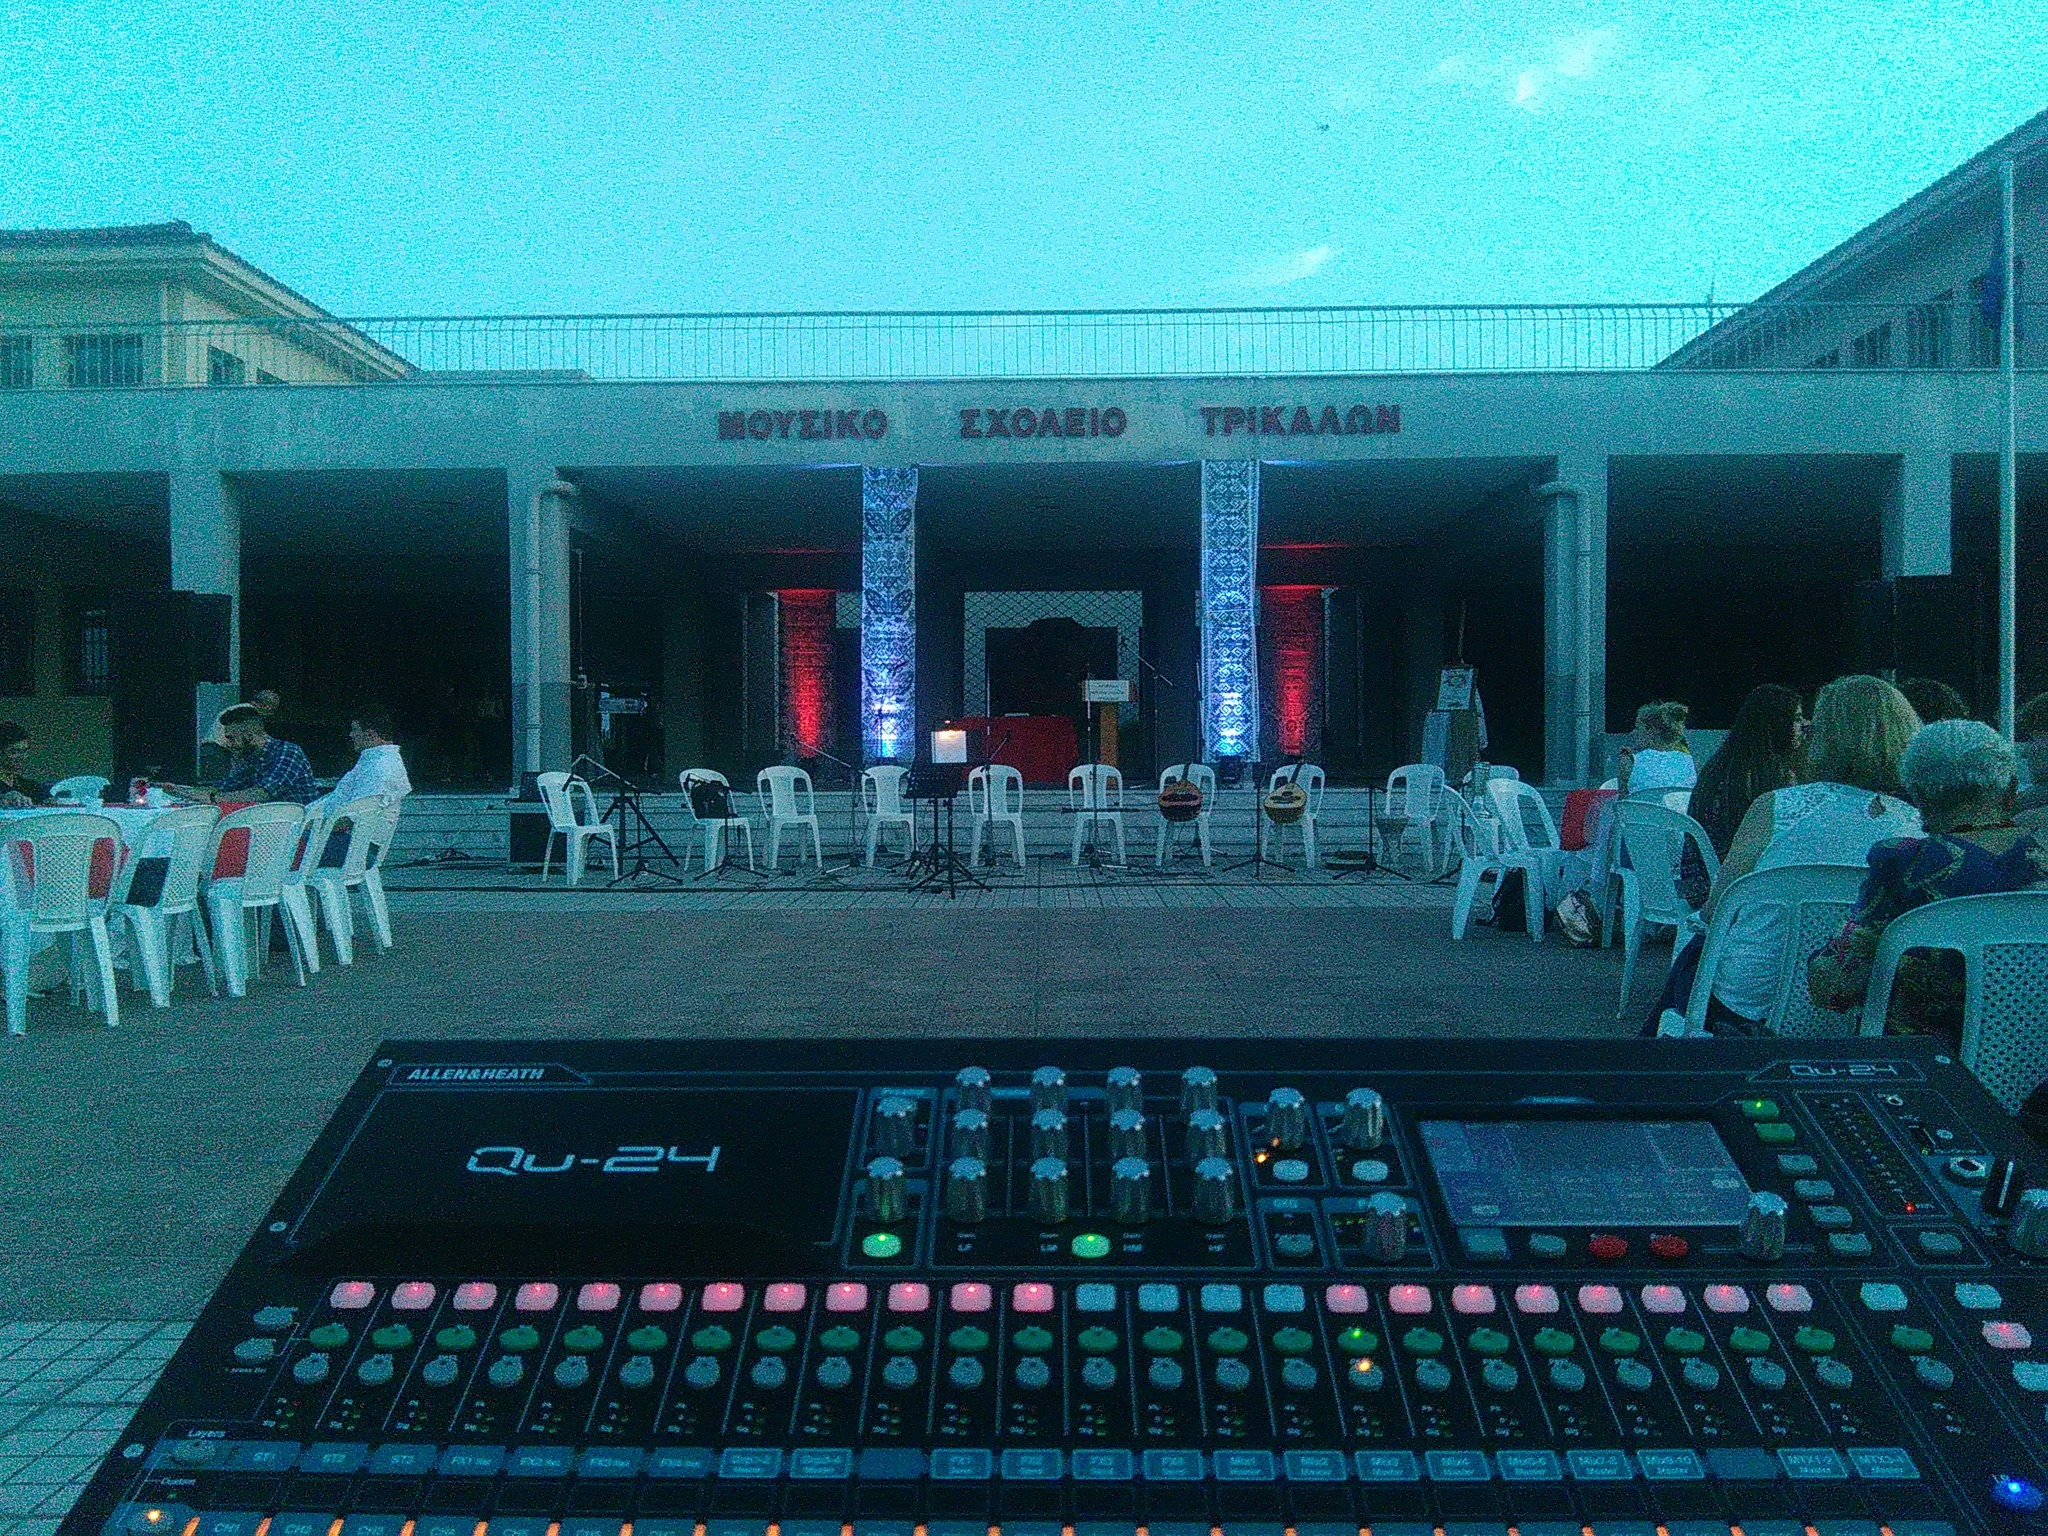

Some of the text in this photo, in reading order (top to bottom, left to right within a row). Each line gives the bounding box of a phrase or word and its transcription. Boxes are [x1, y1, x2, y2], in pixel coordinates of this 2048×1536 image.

[718, 403, 1401, 441] ΜΟΥΣΙΚΟ ΣΧΟΛΕΙΟ ΤΡΙΚΑΛΩΝ
[407, 1068, 544, 1080] ALLEN&HEATH
[466, 1145, 722, 1177] Qu-24
[188, 1428, 226, 1440] Layers
